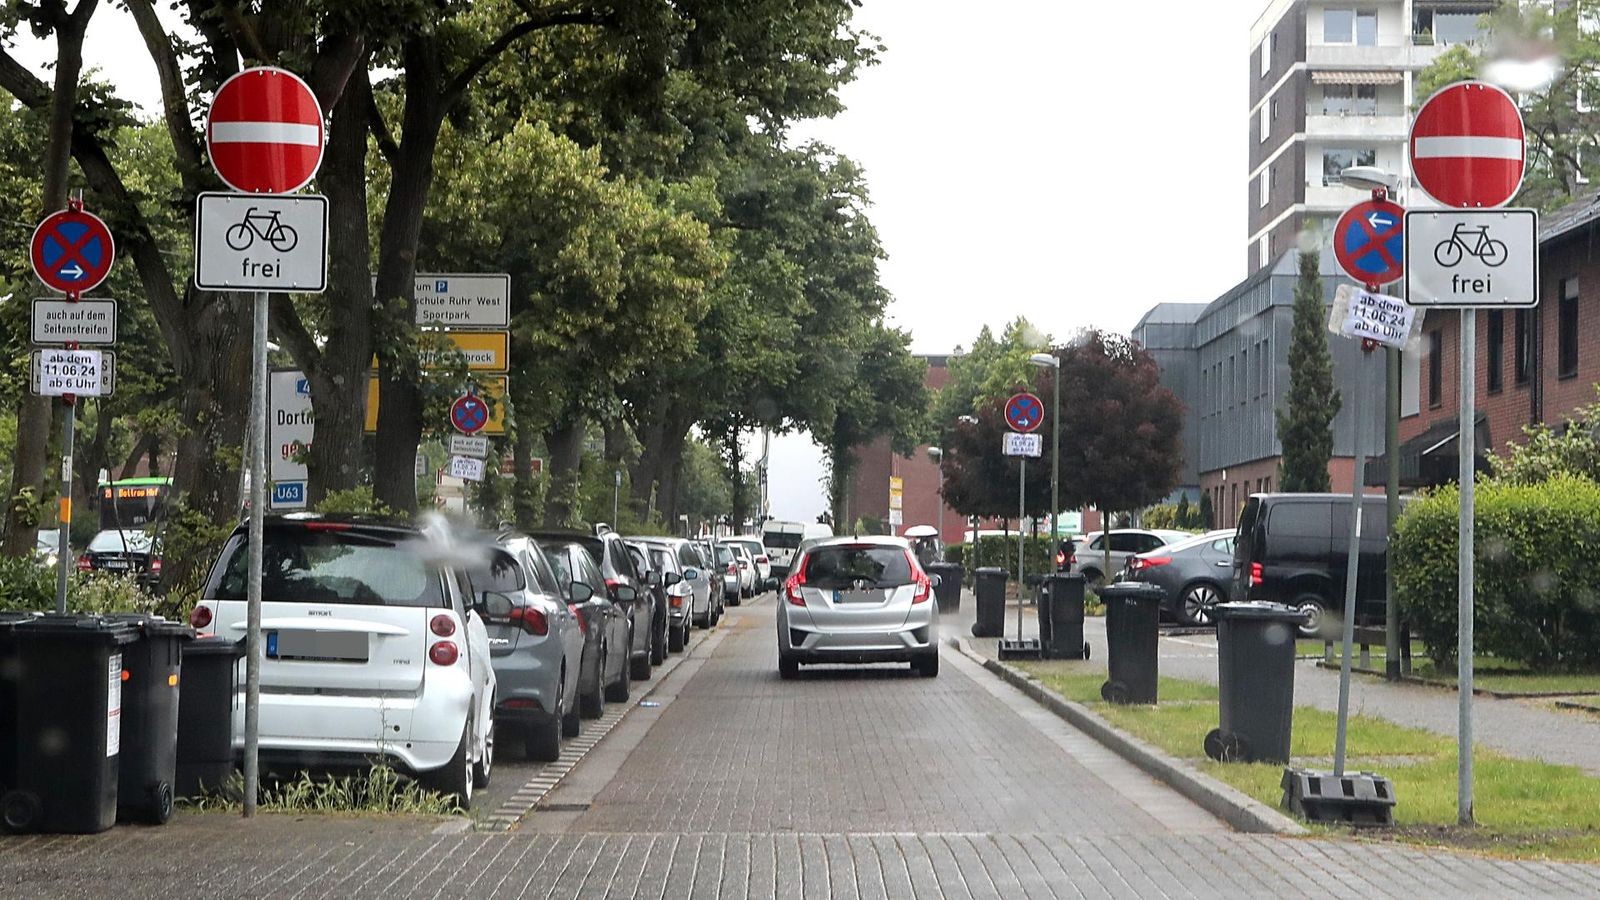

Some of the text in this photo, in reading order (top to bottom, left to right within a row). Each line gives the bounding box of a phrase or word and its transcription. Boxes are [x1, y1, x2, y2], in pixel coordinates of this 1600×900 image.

[242, 258, 281, 278] frei
[416, 283, 431, 291] um
[1451, 274, 1492, 294] frei
[416, 296, 500, 305] schule Ruhr West
[1360, 296, 1404, 313] ab dem
[46, 310, 106, 320] auch auf dem
[423, 310, 470, 320] Sportpark
[1353, 305, 1405, 327] 11.06.24
[44, 323, 108, 335] Seitenstreifen
[1354, 321, 1402, 339] ab 6 Uhr
[50, 353, 92, 364] ab dem
[465, 352, 492, 362] brock
[44, 364, 95, 377] 11.06.24
[49, 377, 63, 388] ab
[66, 378, 72, 388] 6
[76, 378, 96, 389] Uhr
[277, 487, 299, 499] U63
